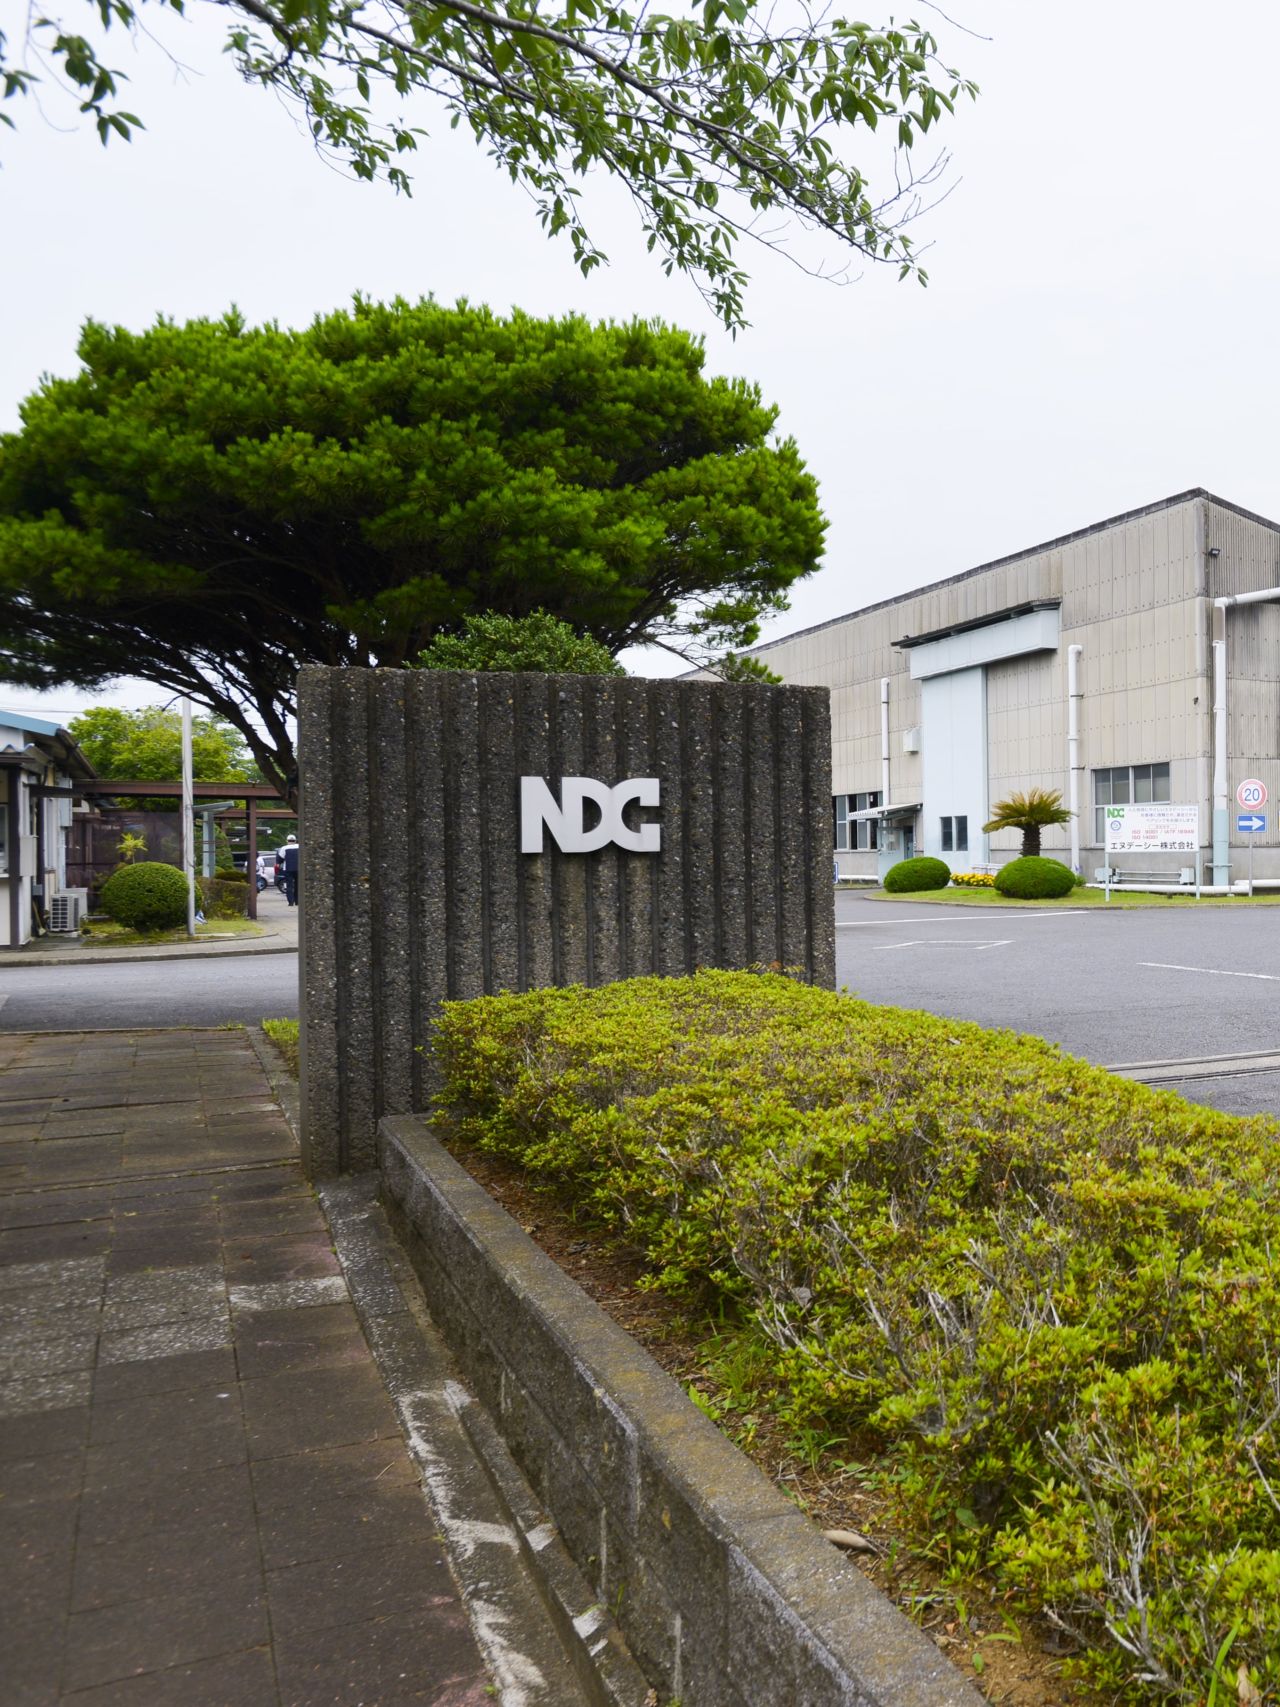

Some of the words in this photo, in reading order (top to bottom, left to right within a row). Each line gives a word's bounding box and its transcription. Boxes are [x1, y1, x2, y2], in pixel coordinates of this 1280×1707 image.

[1244, 788, 1260, 801] 20
[520, 776, 661, 853] NDC
[1107, 808, 1125, 818] NDC
[1111, 841, 1194, 850] エヌデーシー株式会社
